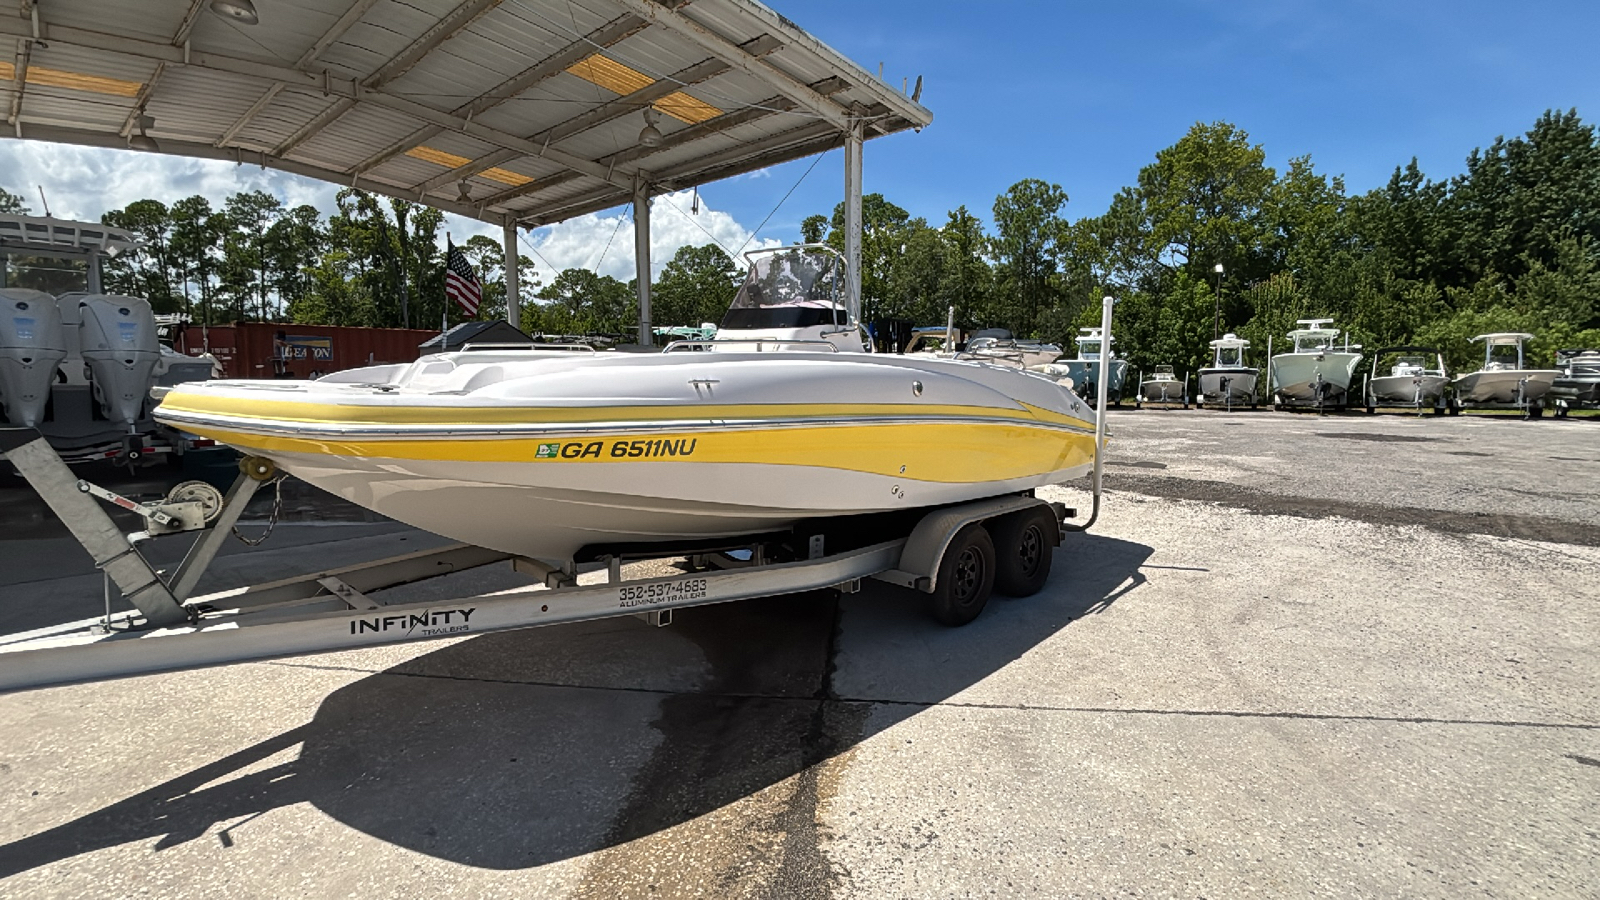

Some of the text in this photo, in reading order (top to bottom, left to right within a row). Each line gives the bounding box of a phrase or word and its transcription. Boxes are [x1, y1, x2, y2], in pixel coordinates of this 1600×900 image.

[561, 438, 697, 459] GA 6511NU
[619, 592, 706, 608] ALUMINUM TRAILERS
[421, 625, 469, 636] TRAILERS
